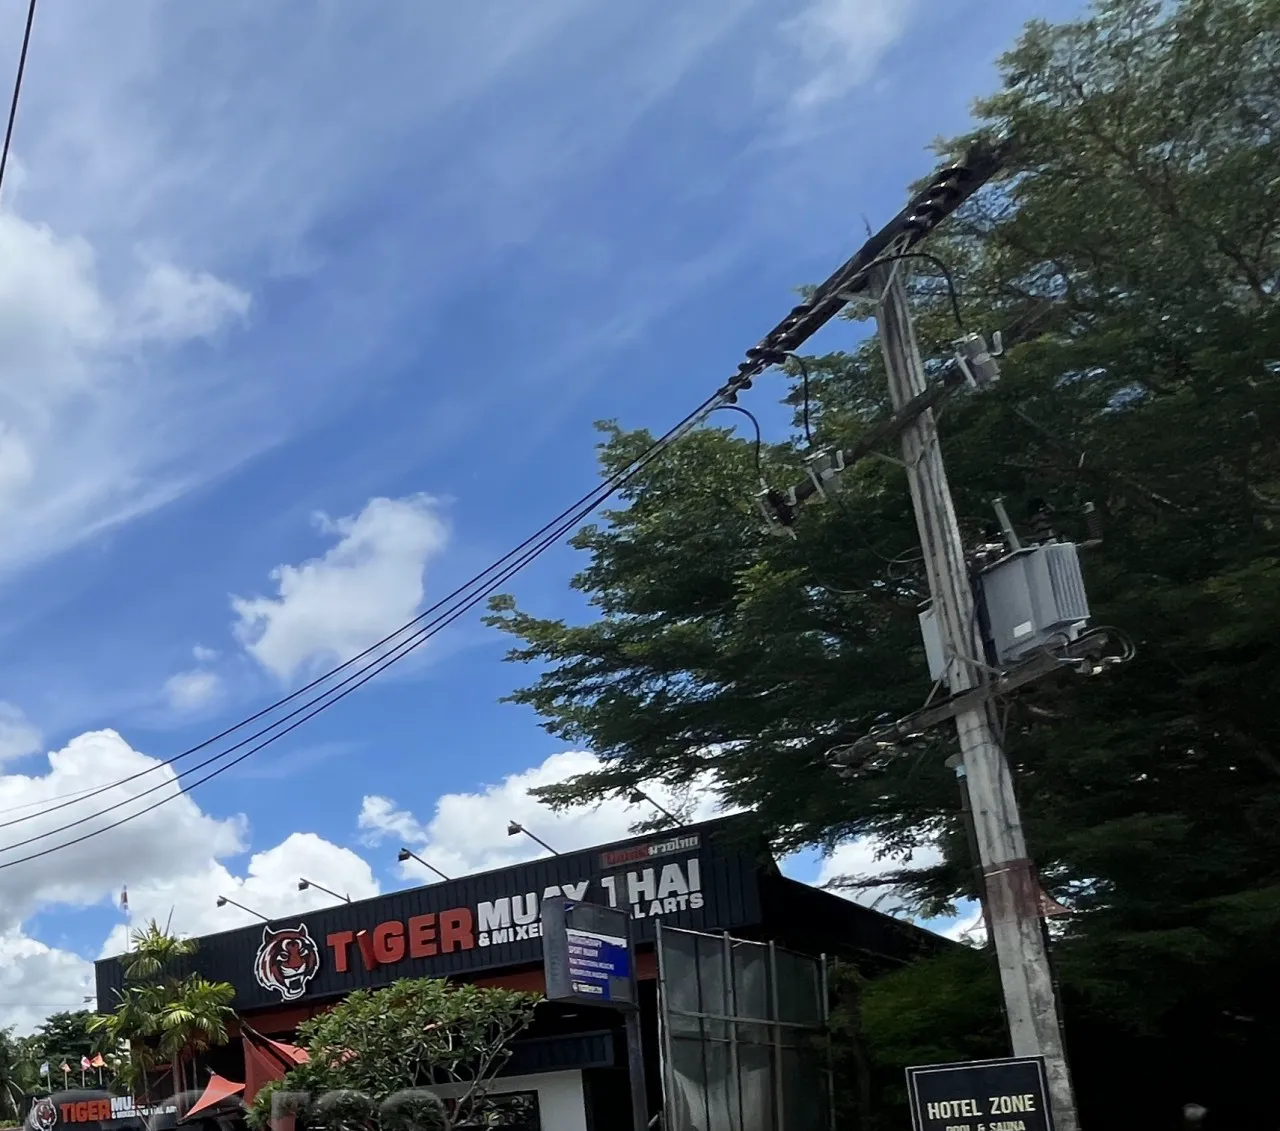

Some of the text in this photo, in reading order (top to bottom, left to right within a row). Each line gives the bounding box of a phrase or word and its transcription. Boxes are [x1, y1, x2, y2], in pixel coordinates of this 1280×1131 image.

[327, 907, 474, 972] TIGER
[601, 858, 701, 908] THAI
[478, 931, 490, 947] &
[492, 923, 543, 945] MIXE
[649, 892, 704, 917] ARTS
[60, 1099, 111, 1123] TIGER
[927, 1094, 1037, 1120] HOTEL ZONE
